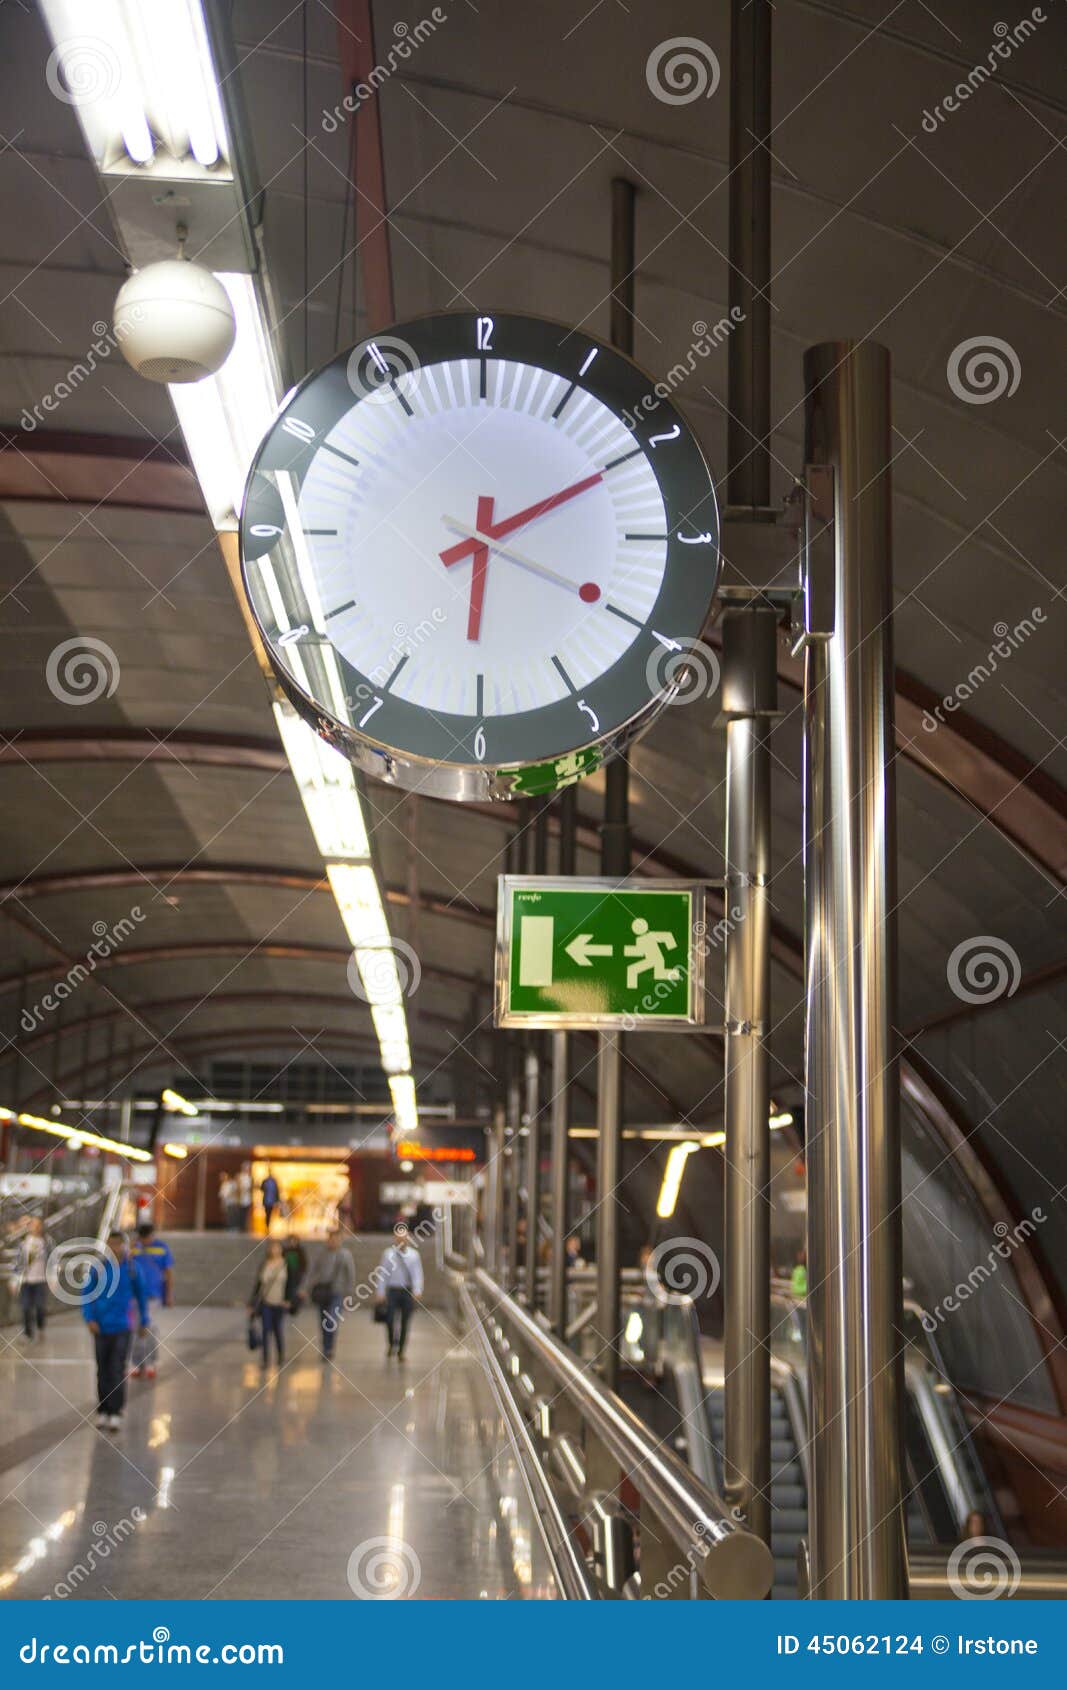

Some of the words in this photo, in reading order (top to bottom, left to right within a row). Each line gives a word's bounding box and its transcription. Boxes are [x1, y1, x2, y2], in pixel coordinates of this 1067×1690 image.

[476, 316, 495, 351] 12
[578, 348, 598, 377] 1
[282, 416, 316, 444] 10
[648, 424, 681, 448] 2
[249, 523, 284, 538] 9
[676, 531, 713, 545] 3
[651, 629, 682, 652] 4
[359, 695, 384, 728] 7
[576, 699, 600, 732] 5
[473, 726, 486, 760] 6
